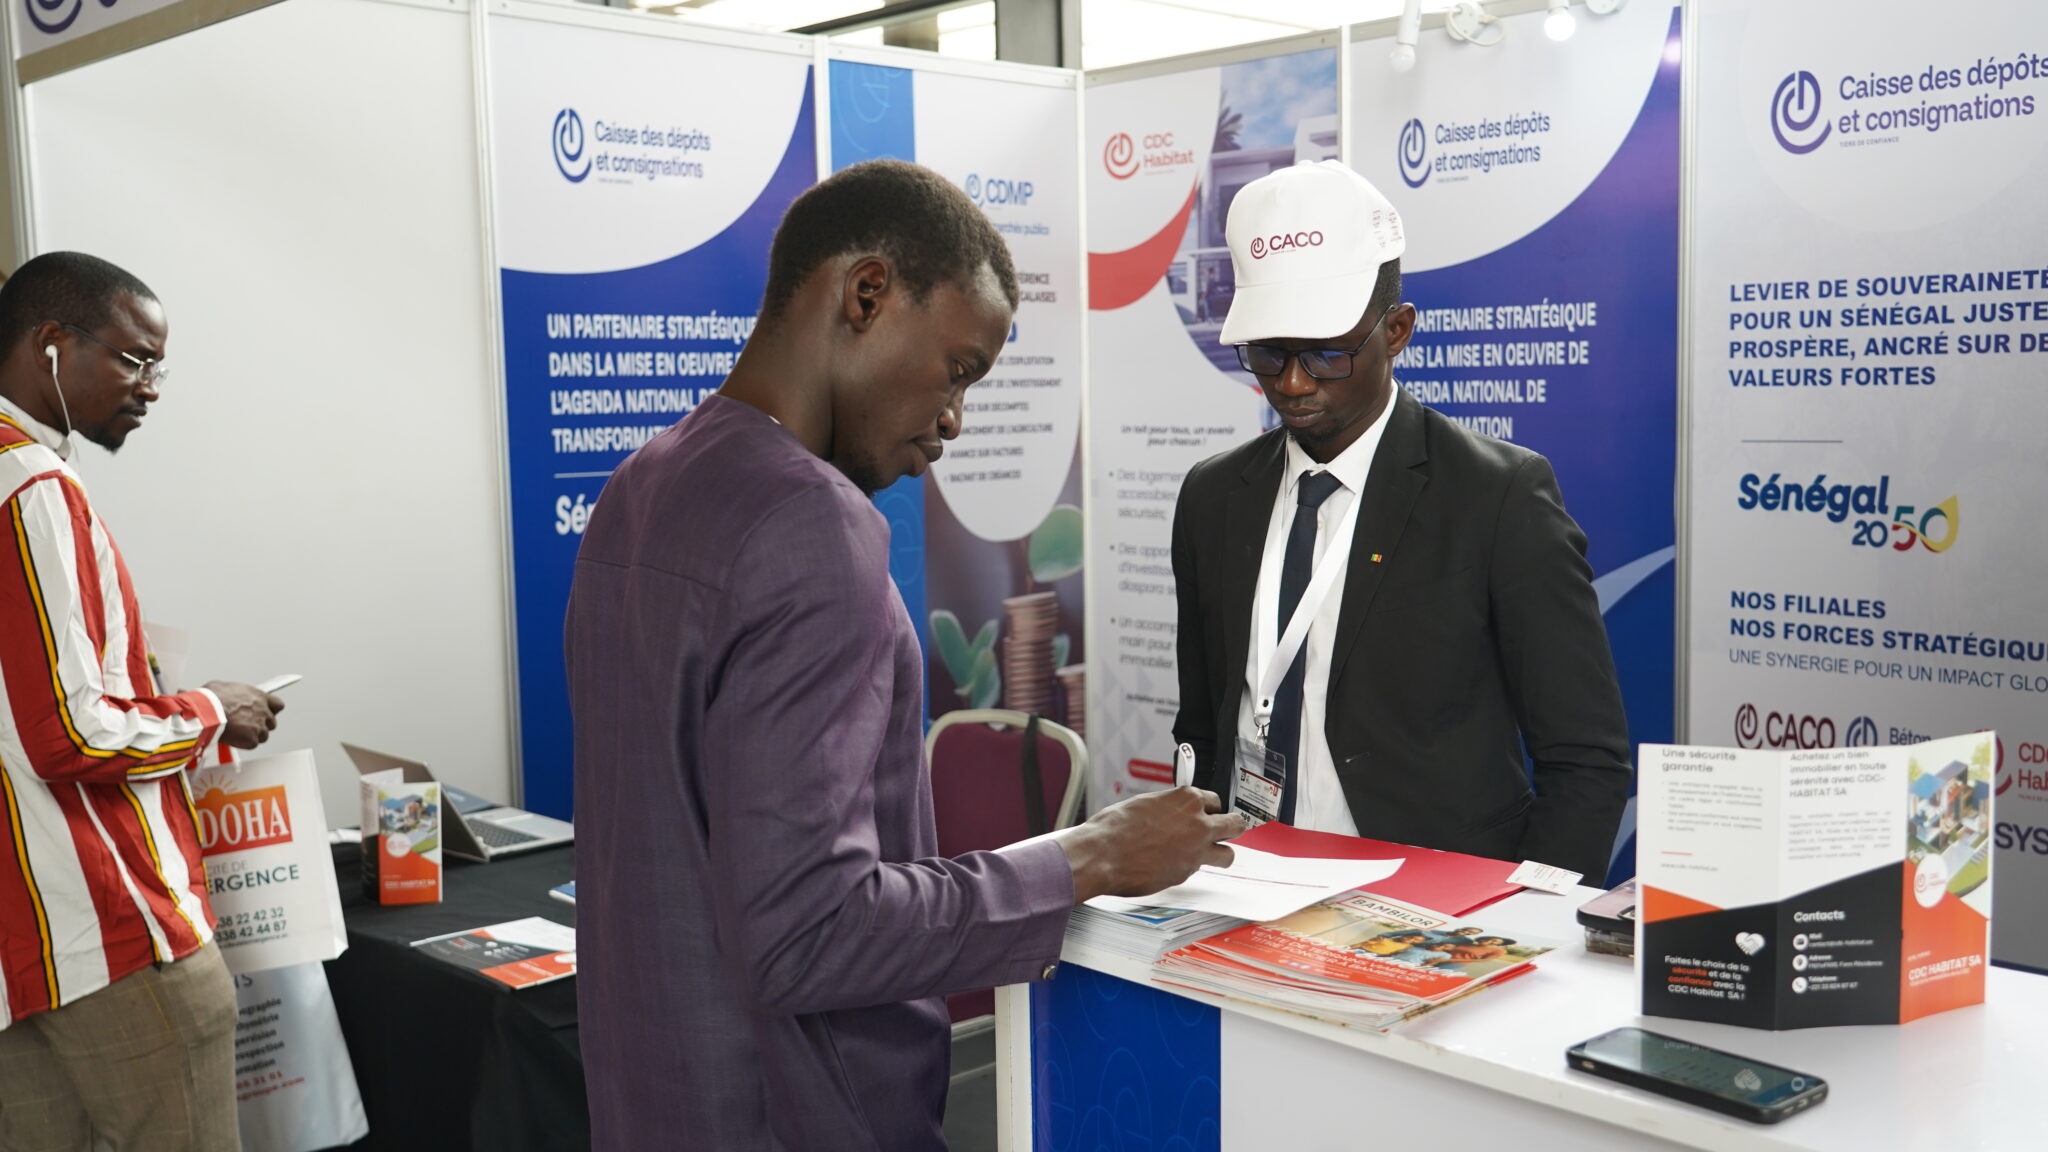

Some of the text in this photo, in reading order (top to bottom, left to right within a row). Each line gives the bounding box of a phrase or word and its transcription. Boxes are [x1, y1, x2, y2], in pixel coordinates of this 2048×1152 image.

[1839, 52, 2048, 101] Caisse des dépôts
[1838, 92, 2035, 134] et consignations
[594, 120, 711, 154] Caisse des dépôts
[1435, 110, 1551, 145] Caisse des dépôts
[1143, 132, 1174, 150] CDC
[596, 151, 704, 180] et consignations
[1143, 150, 1195, 169] Habitat
[1435, 143, 1541, 173] et consignations
[986, 179, 1034, 206] CDMP
[1269, 230, 1324, 251] CACO
[1730, 280, 1810, 302] LEVIER
[1818, 280, 1848, 299] DE
[547, 313, 572, 339] UN
[574, 314, 665, 340] PARTENAIRE
[1496, 297, 1597, 332] STRATÉGIQUE
[1729, 301, 2048, 330] POUR UN SÉNÉGAL JUSTE
[1427, 345, 1446, 368] LA
[1447, 343, 1481, 368] MISE
[1483, 343, 1503, 367] EN
[1505, 341, 1565, 367] OEUVRE
[1568, 340, 1589, 365] DE
[1729, 335, 1856, 360] PROSPÈRE,
[1864, 331, 1949, 356] ANCRÉ
[1957, 333, 2011, 355] SUR
[549, 352, 593, 378] DANS
[595, 352, 616, 377] LA
[617, 352, 654, 377] MISE
[655, 352, 676, 377] EN
[677, 352, 734, 376] OEUVRE
[1728, 366, 1936, 387] VALEURS FORTES
[551, 388, 697, 416] L'AGENDA NATIONAL
[1402, 379, 1547, 404] GENDA NATIONAL DE
[1738, 473, 1890, 523] Sénégal
[555, 493, 596, 536] Sé
[1852, 495, 1959, 553] 2050
[1730, 591, 1886, 619] NOS FILIALES
[1729, 618, 2048, 662] NOS FORCES STRATÉGIQU
[1729, 648, 2048, 693] UNE SYNERGIE POUR UN IMPACT GLO
[1766, 711, 1836, 750] CACO
[1662, 748, 1737, 761] Une sécurité
[1790, 752, 1830, 762] Achetez
[1847, 751, 1870, 760] bien
[2018, 742, 2048, 765] CD
[1661, 762, 1714, 773] garantie
[1790, 762, 1887, 774] immobilier en toute
[1831, 776, 1856, 784] avec
[2018, 768, 2048, 792] Ha
[1789, 787, 1848, 798] HABITAT SA
[199, 796, 290, 849] DOHA
[231, 860, 248, 873] DE
[216, 907, 285, 930] 38 22 42 32
[1351, 898, 1434, 928] BAMBILOR
[1793, 909, 1846, 923] Contacts
[239, 925, 254, 939] 42
[256, 922, 272, 935] 44
[1251, 929, 1290, 945] VENTE
[1251, 936, 1281, 949] TITRE
[1664, 955, 1750, 973] Faites le choix de la
[1708, 970, 1718, 978] et
[1719, 971, 1732, 980] de
[1732, 972, 1742, 981] la
[1907, 965, 1928, 982] CDC
[1928, 957, 1969, 976] HABITAT
[1968, 954, 1982, 968] SA
[1668, 984, 1690, 994] CDC
[1690, 986, 1725, 998] Habitat
[1727, 990, 1740, 1000] SA
[1713, 980, 1736, 990] avec
[1736, 981, 1746, 991] la
